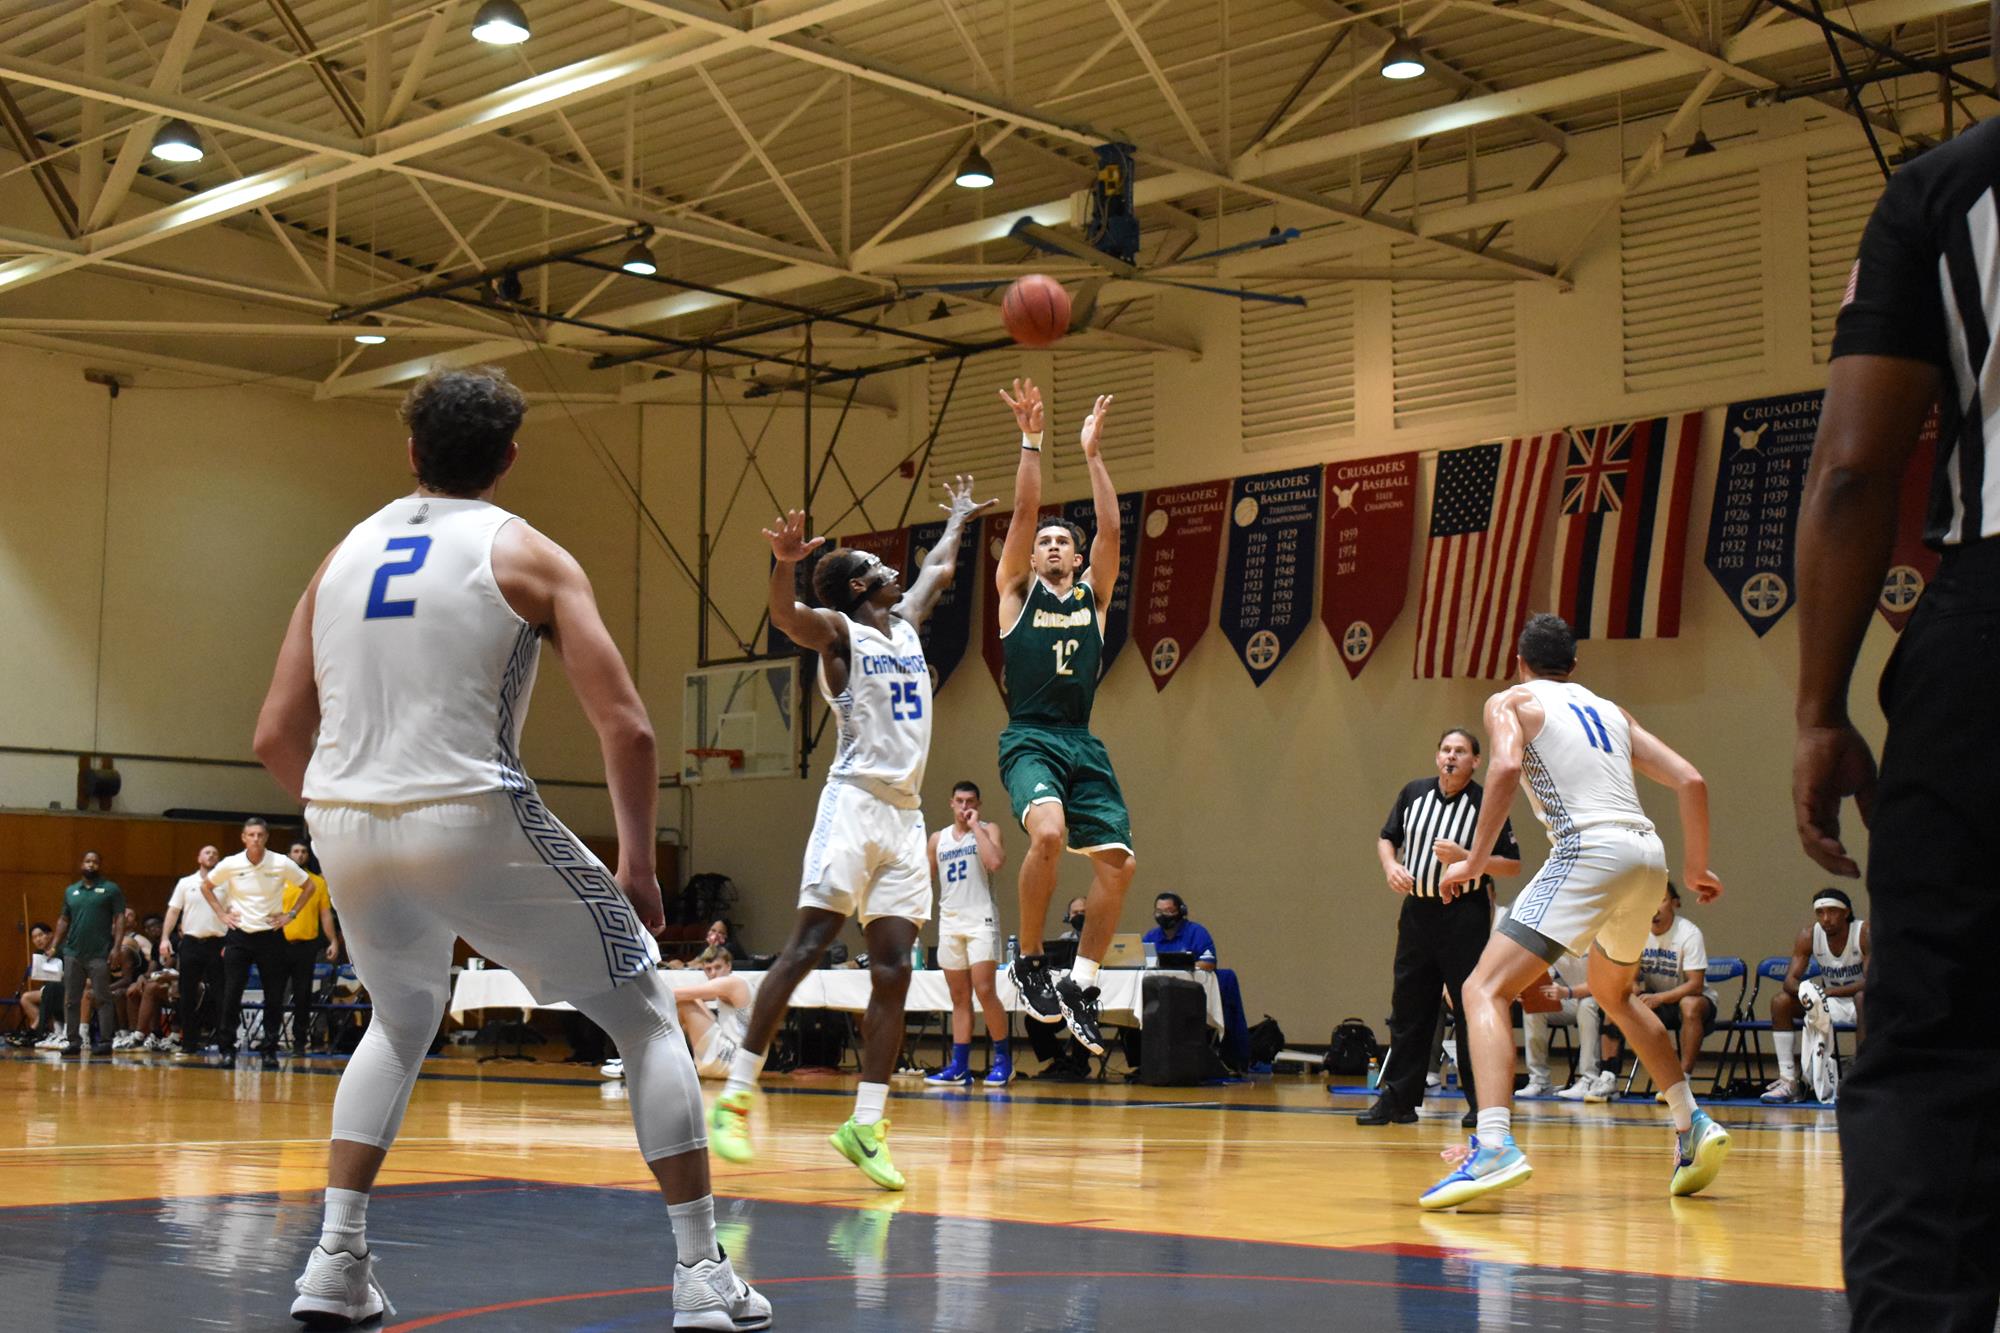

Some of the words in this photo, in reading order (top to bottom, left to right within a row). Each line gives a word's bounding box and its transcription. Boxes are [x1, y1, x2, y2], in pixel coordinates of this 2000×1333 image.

[1773, 417, 1817, 432] BASEBA
[1776, 432, 1815, 444] TERRITOR
[1338, 460, 1405, 480] CRUSADERS
[1731, 462, 1756, 476] 1923
[1766, 458, 1791, 473] 1934
[1245, 474, 1310, 493] CRUSADERS
[1362, 476, 1410, 491] BASEBALL
[1729, 478, 1754, 491] 1924
[1764, 475, 1790, 488] 1936
[1156, 488, 1218, 506] CRUSADERS
[1260, 488, 1318, 505] BASKETBALL
[1727, 494, 1752, 507] 1925
[1762, 490, 1788, 505] 1939
[1170, 501, 1225, 517] BASKETBALL
[1724, 509, 1750, 522] 1926
[1761, 506, 1787, 520] 1940
[1722, 524, 1748, 538] 1930
[1759, 523, 1784, 536] 1941
[1248, 533, 1268, 544] 1916
[1720, 540, 1746, 553] 1932
[1757, 539, 1783, 553] 1942
[1247, 544, 1266, 555] 1917
[1338, 544, 1357, 559] 1974
[1246, 556, 1265, 568] 1919
[1336, 561, 1356, 576] 2014
[1718, 555, 1744, 569] 1933
[1755, 554, 1782, 568] 1943
[364, 535, 434, 620] 2
[1245, 569, 1264, 580] 1921
[1243, 580, 1263, 592] 1923
[1242, 592, 1262, 604] 1924
[1241, 605, 1260, 616] 1926
[1240, 617, 1260, 628] 1927
[863, 655, 926, 675] CHAMADE
[1052, 639, 1080, 676] 12
[889, 682, 922, 721] 25
[1568, 702, 1614, 753] 11
[947, 859, 967, 883] 22
